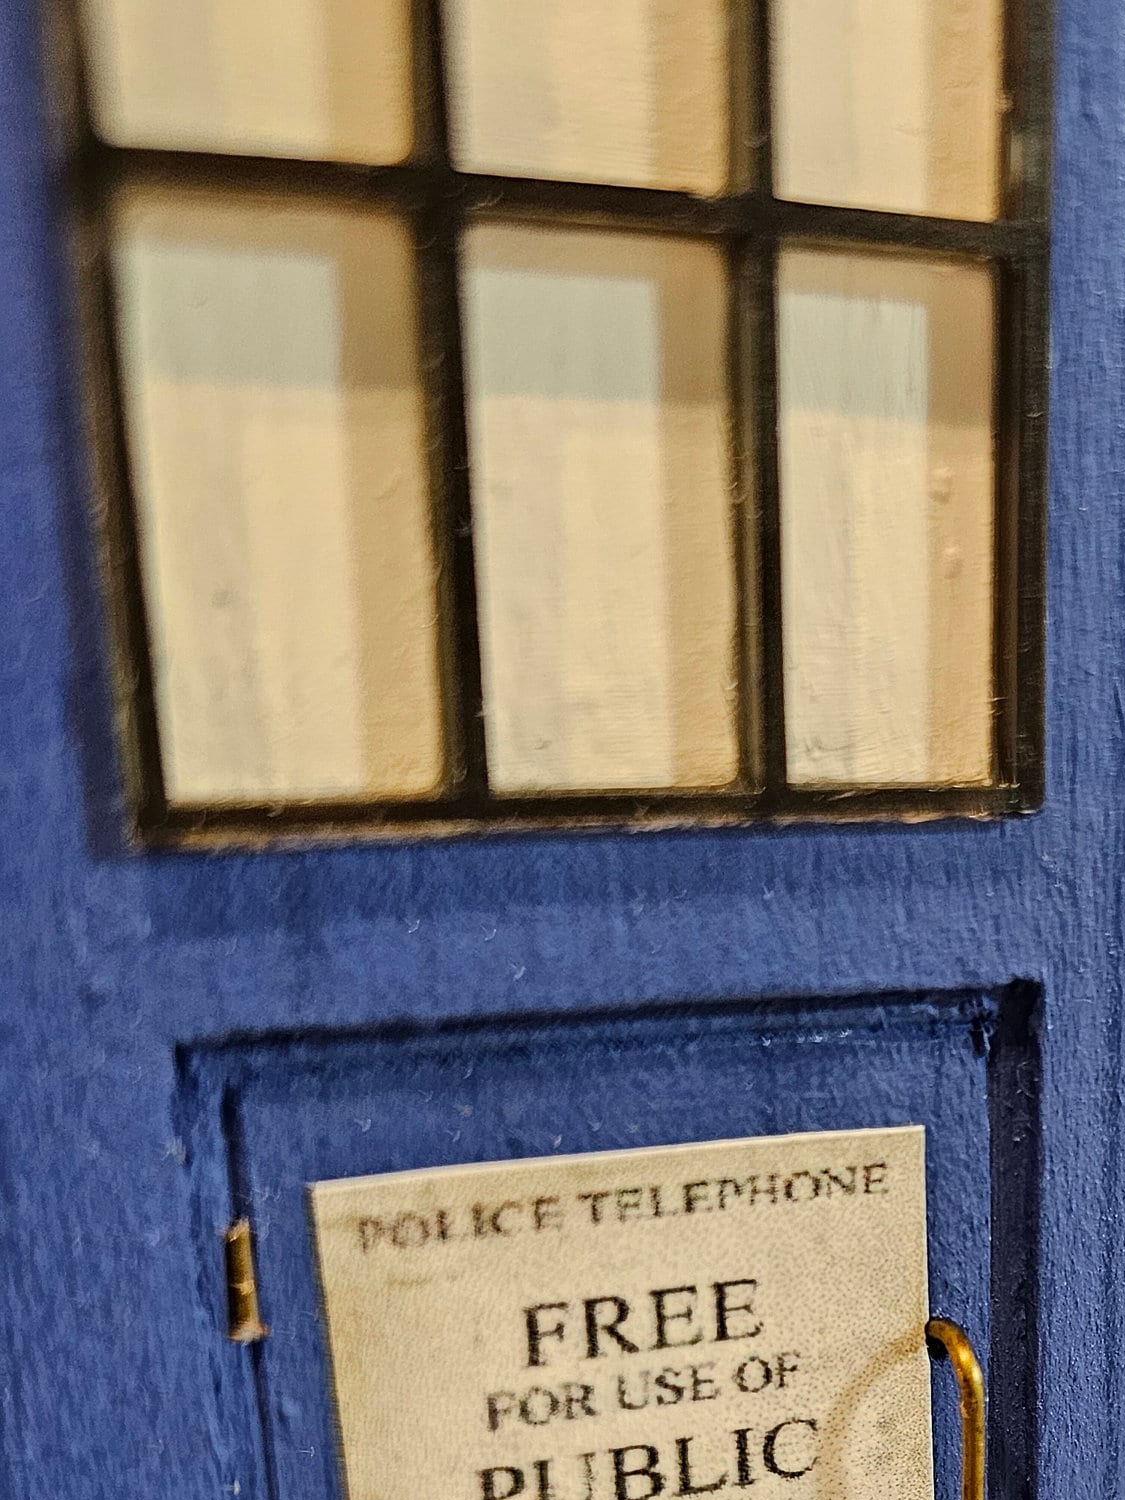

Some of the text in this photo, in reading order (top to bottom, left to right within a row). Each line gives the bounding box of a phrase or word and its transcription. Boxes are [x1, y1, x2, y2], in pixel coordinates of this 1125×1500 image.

[357, 1162, 890, 1254] POLICE TELEPHONE
[523, 1278, 764, 1367] FREE
[487, 1351, 801, 1432] FOR USE OF
